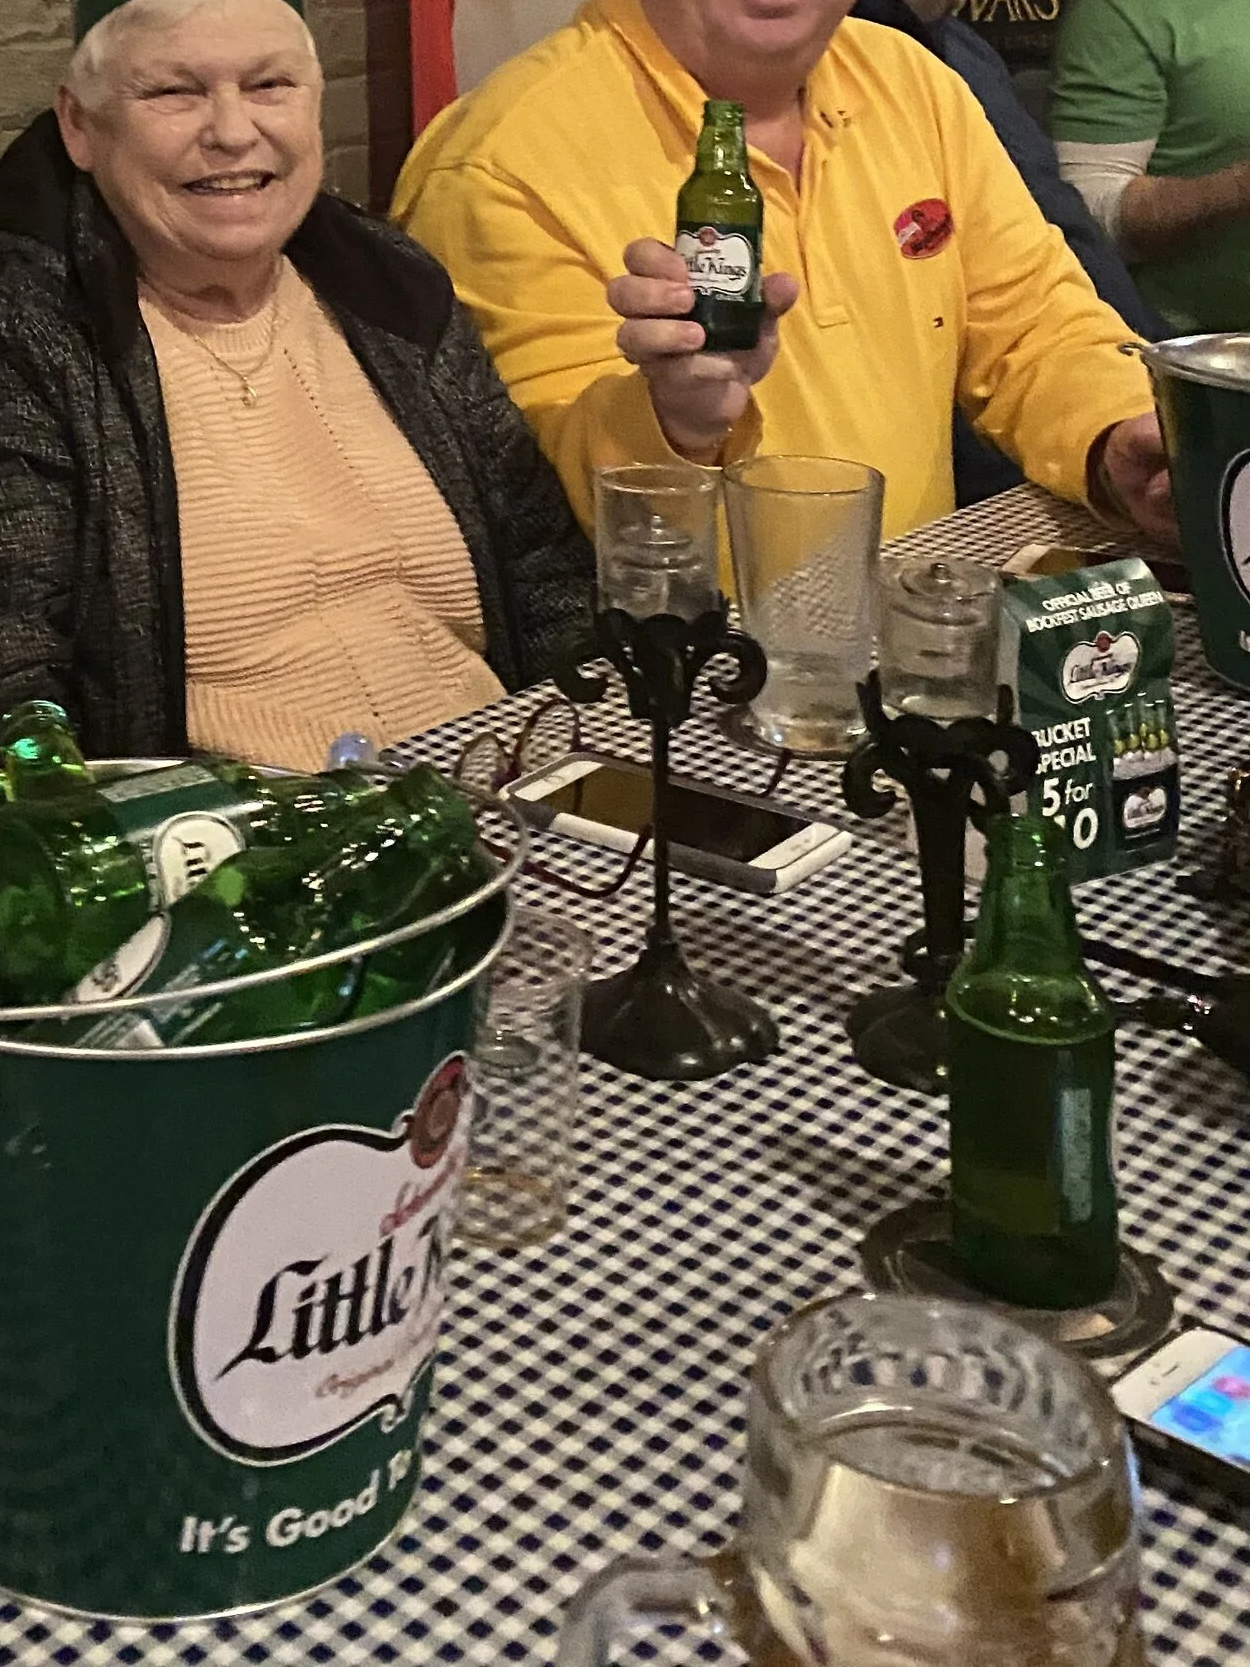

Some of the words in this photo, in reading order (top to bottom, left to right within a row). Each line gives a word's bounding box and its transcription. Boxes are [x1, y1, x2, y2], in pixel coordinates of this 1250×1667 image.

[1025, 608, 1081, 633] BOCKFEST
[1079, 598, 1129, 621] SAUSAGE
[1126, 591, 1165, 610] QUEEN
[1035, 742, 1097, 775] PECIAL
[1042, 777, 1061, 817] 5
[1064, 779, 1094, 805] for
[215, 1235, 415, 1381] Little
[179, 1514, 250, 1554] It's
[265, 1468, 382, 1548] Good
